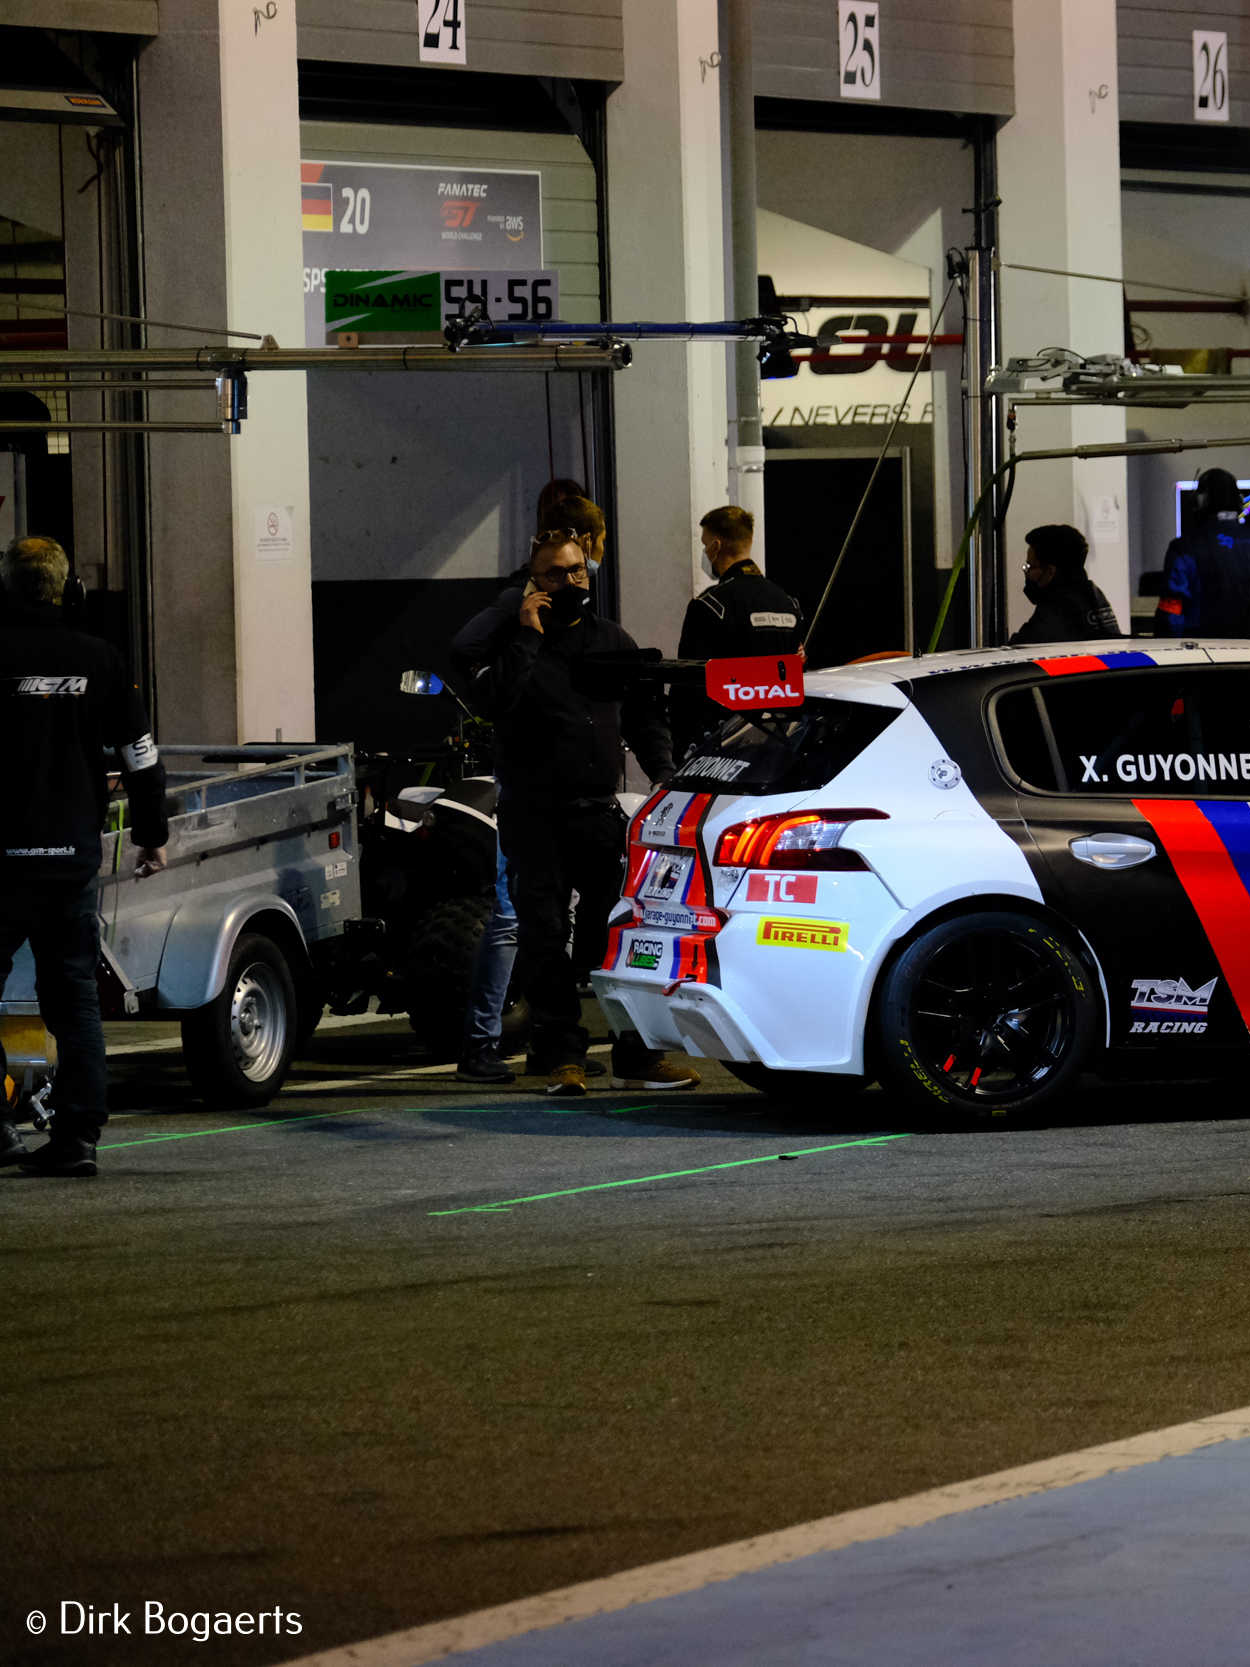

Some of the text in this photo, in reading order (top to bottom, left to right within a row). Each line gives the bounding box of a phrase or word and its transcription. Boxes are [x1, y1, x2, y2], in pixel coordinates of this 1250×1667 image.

[423, 0, 461, 50] 24
[843, 11, 876, 87] 25
[1199, 41, 1225, 110] 26
[438, 183, 488, 197] FANATEC
[340, 187, 371, 234] 20
[332, 293, 433, 308] DINAMIC
[790, 404, 911, 426] NEVERS
[723, 684, 800, 700] TOTAL
[1079, 755, 1108, 782] X.
[764, 875, 796, 903] TC
[763, 921, 841, 946] PIRELLI
[634, 941, 662, 956] RACING
[1129, 1021, 1208, 1033] RACING
